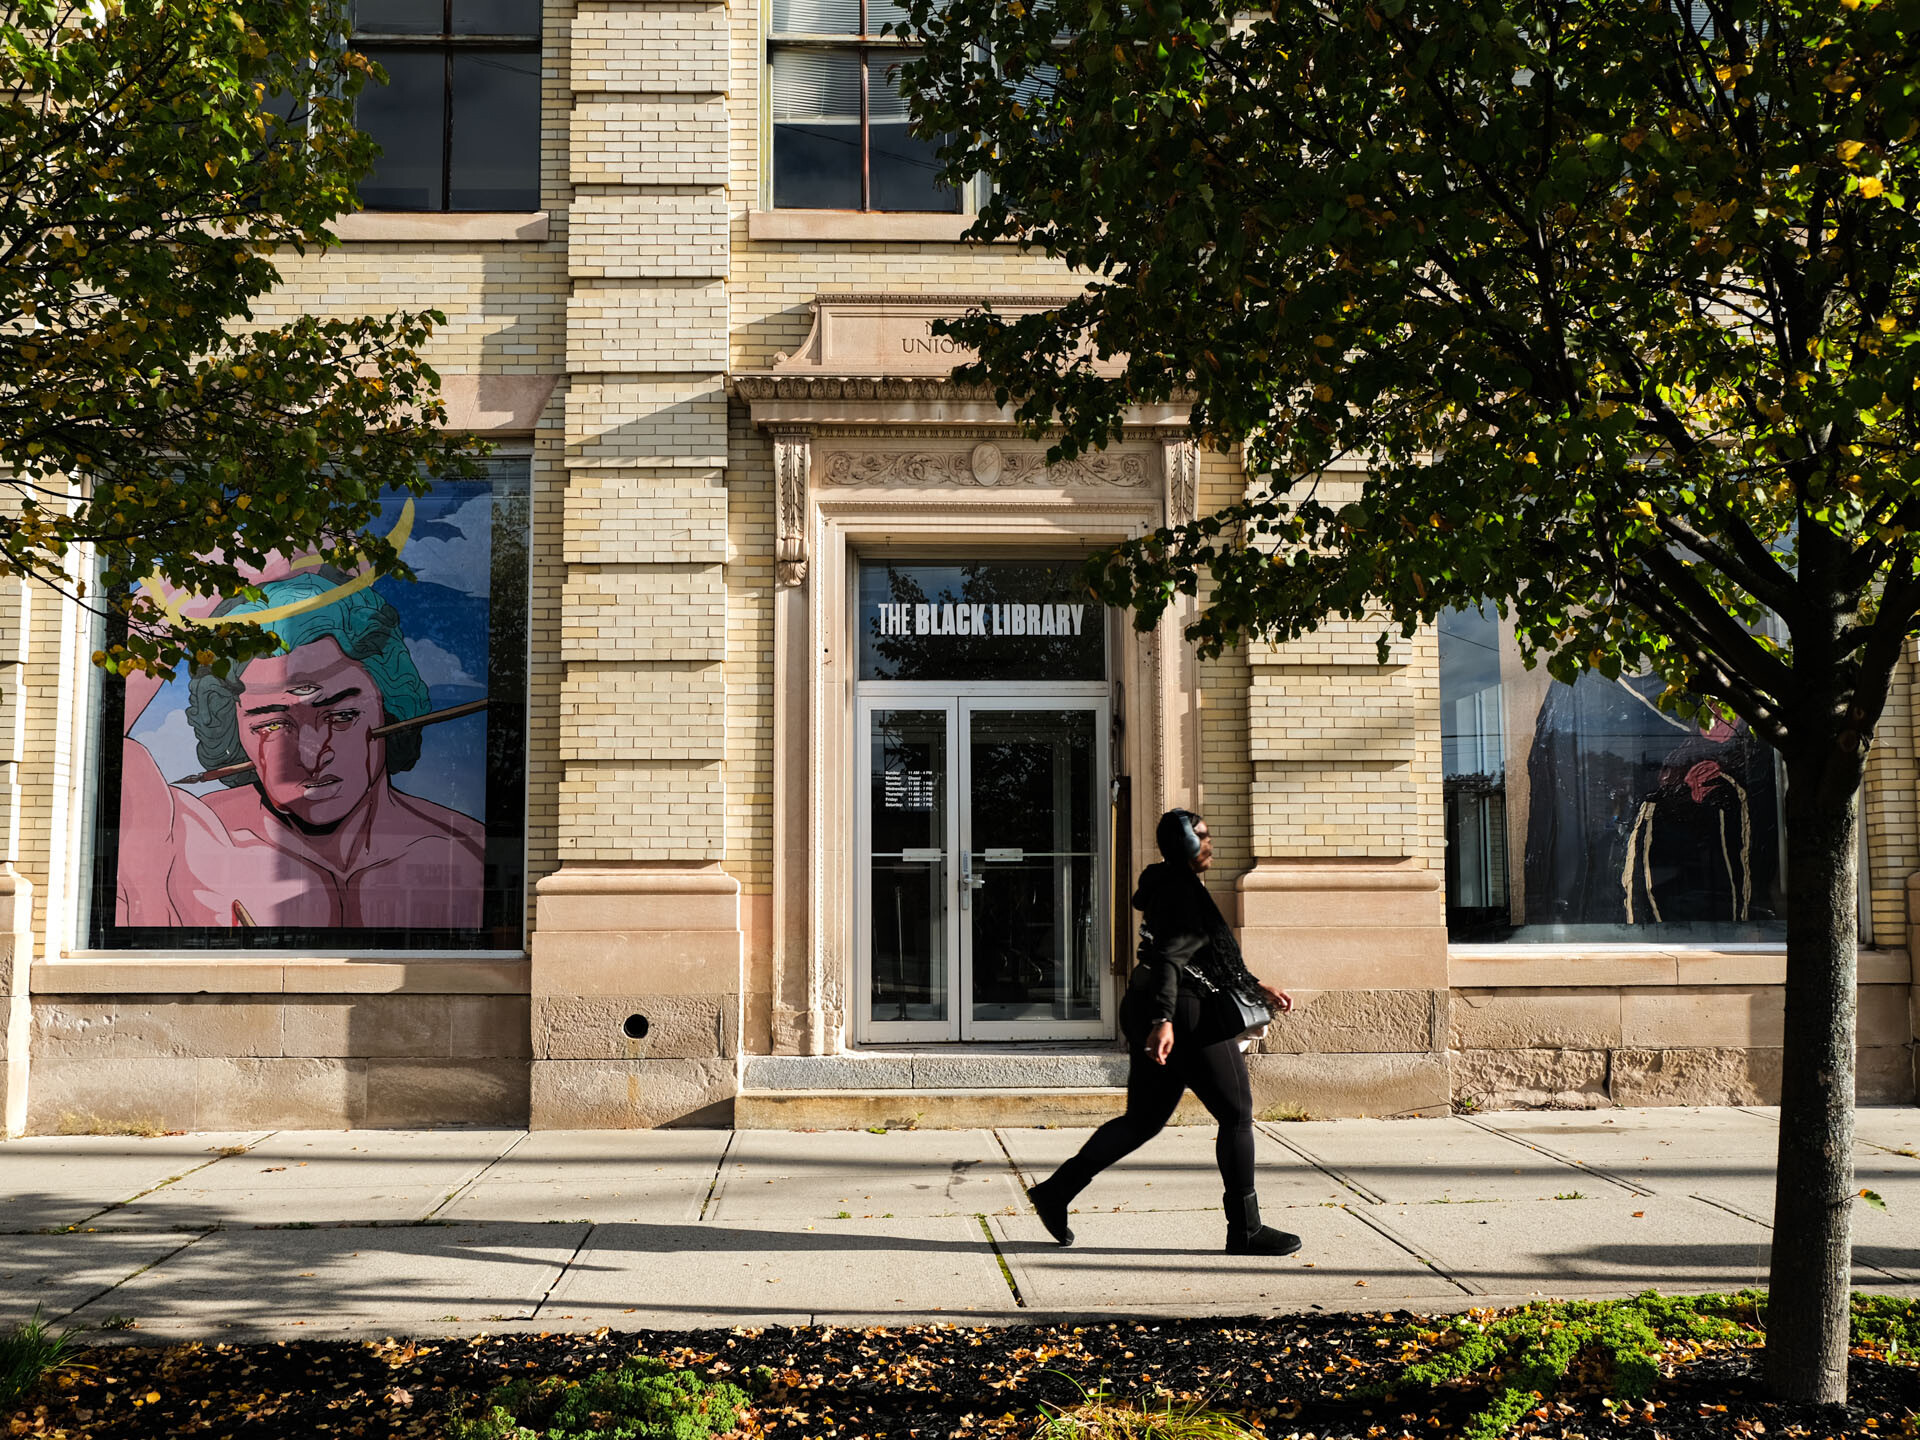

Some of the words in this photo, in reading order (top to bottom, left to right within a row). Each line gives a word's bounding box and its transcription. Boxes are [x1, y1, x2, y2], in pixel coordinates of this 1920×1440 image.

[878, 603, 911, 635] THE
[915, 603, 986, 636] BLACK
[992, 603, 1084, 636] LIBRARY
